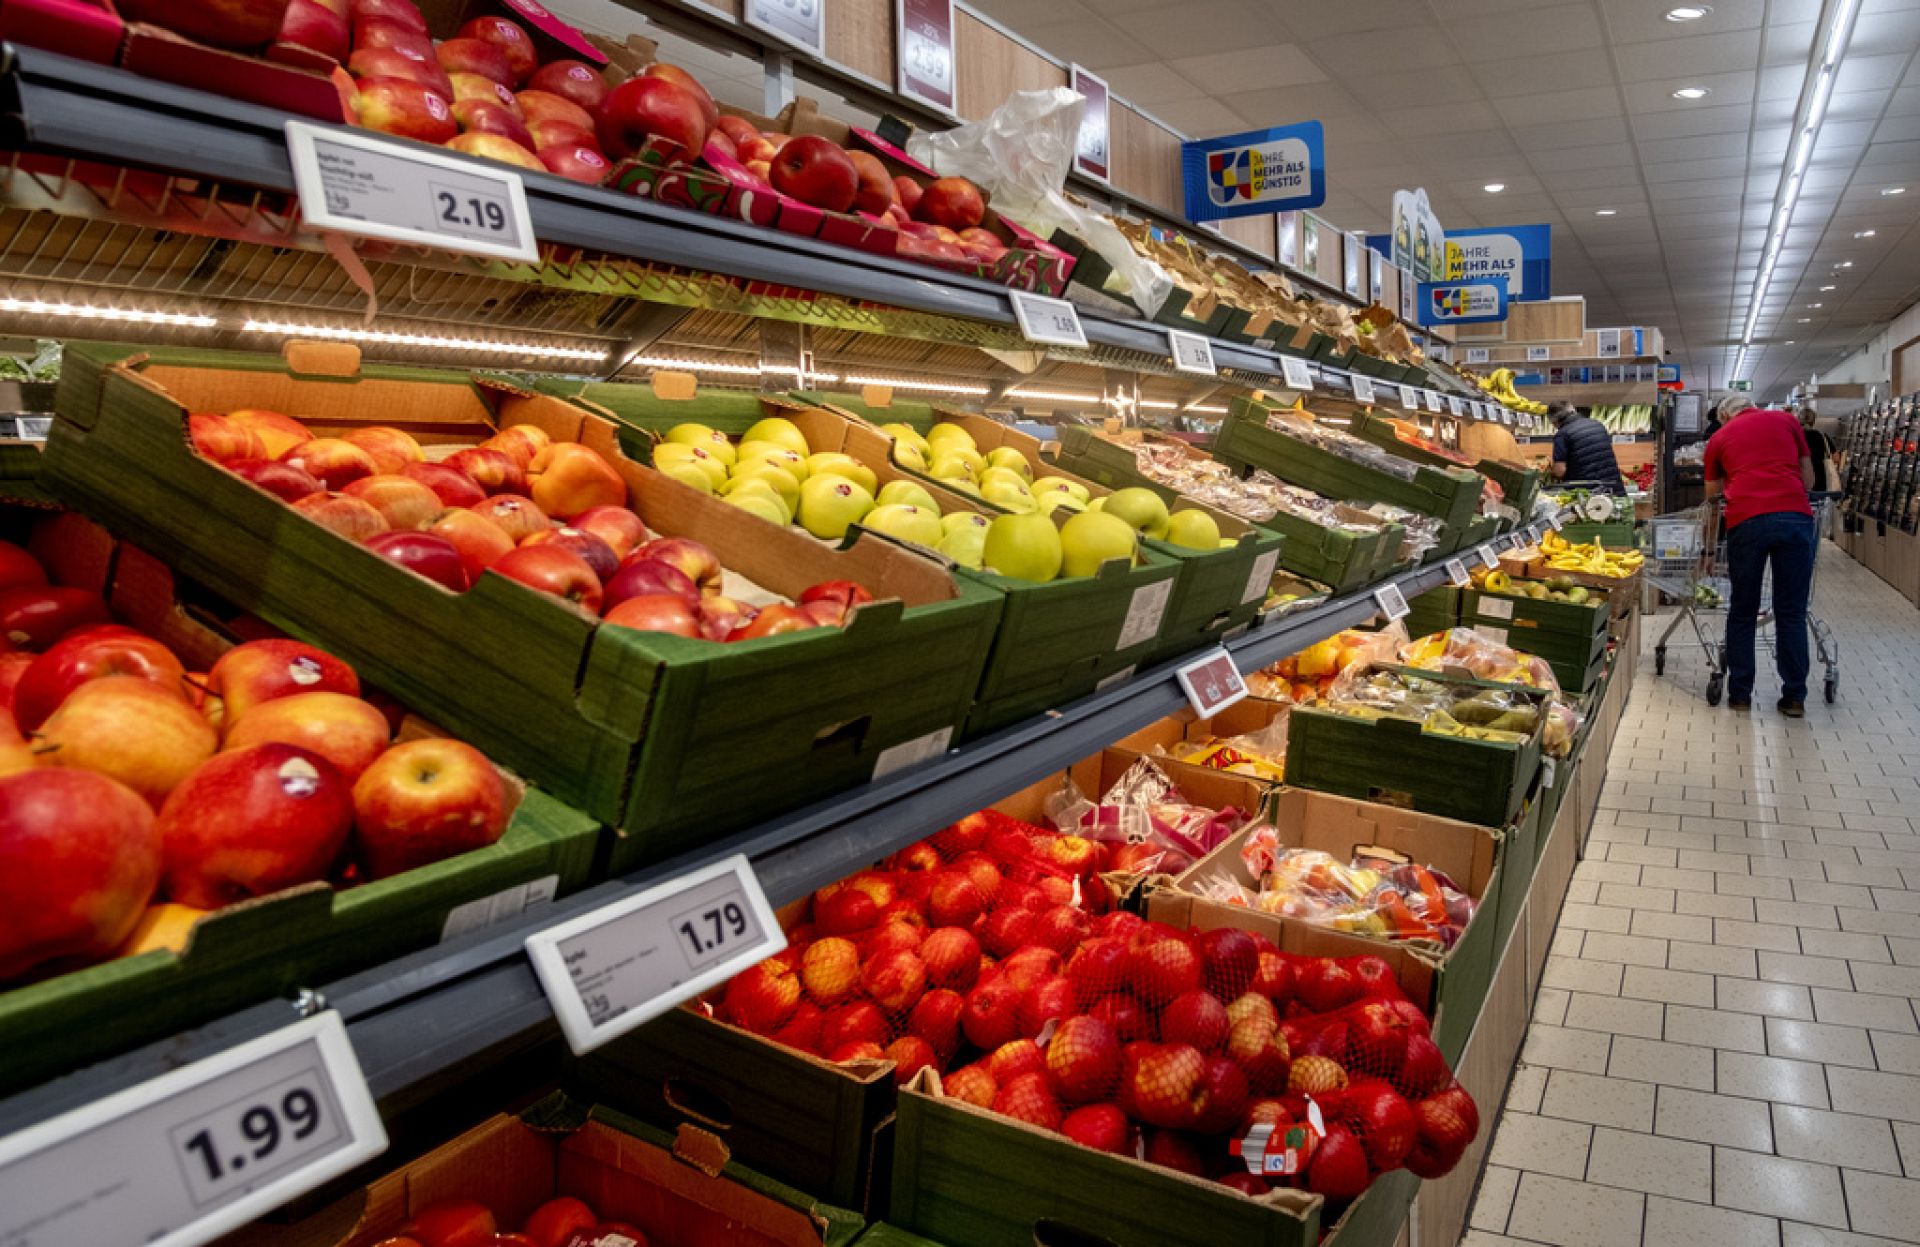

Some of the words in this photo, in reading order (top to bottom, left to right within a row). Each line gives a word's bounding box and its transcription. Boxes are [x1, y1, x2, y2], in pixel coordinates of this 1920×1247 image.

[913, 44, 944, 78] 2.99
[1254, 151, 1284, 165] JAHRE
[1254, 164, 1284, 178] MEHR
[1286, 160, 1304, 174] ALS
[1253, 175, 1302, 191] GÜNSTIG
[438, 192, 505, 231] 2.19
[1450, 247, 1490, 259] JAHRE
[1450, 260, 1488, 272] MEHR
[1491, 258, 1515, 270] ALS
[679, 901, 747, 954] 1.79
[184, 1086, 321, 1181] 1.99
